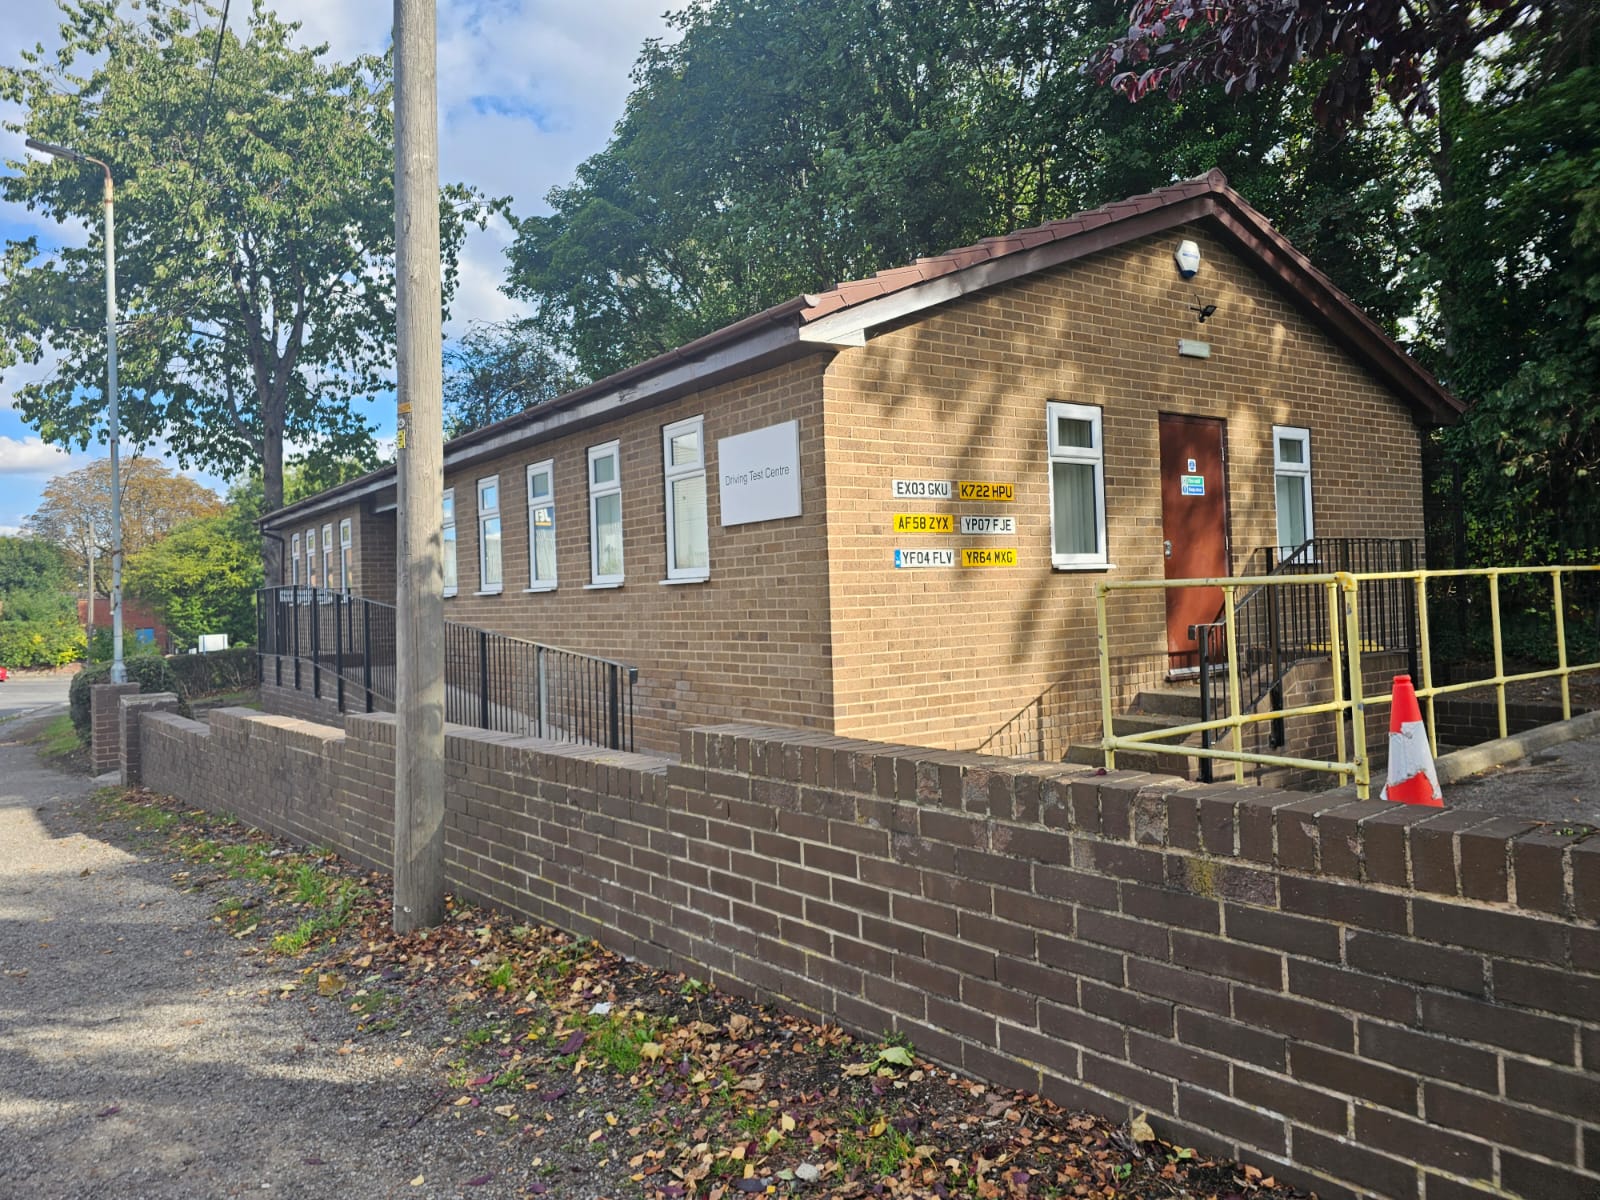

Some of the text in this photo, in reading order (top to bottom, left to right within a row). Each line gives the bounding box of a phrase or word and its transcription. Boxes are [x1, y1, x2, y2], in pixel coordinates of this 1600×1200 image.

[725, 466, 789, 486] Driving Test Centre
[897, 482, 948, 495] EX03 GKU
[961, 485, 1012, 498] K722 HPU
[898, 517, 949, 529] AF58 ZYX
[965, 518, 990, 531] YP07
[902, 551, 930, 564] YF04
[933, 551, 952, 564] FLV
[966, 551, 991, 564] YR64
